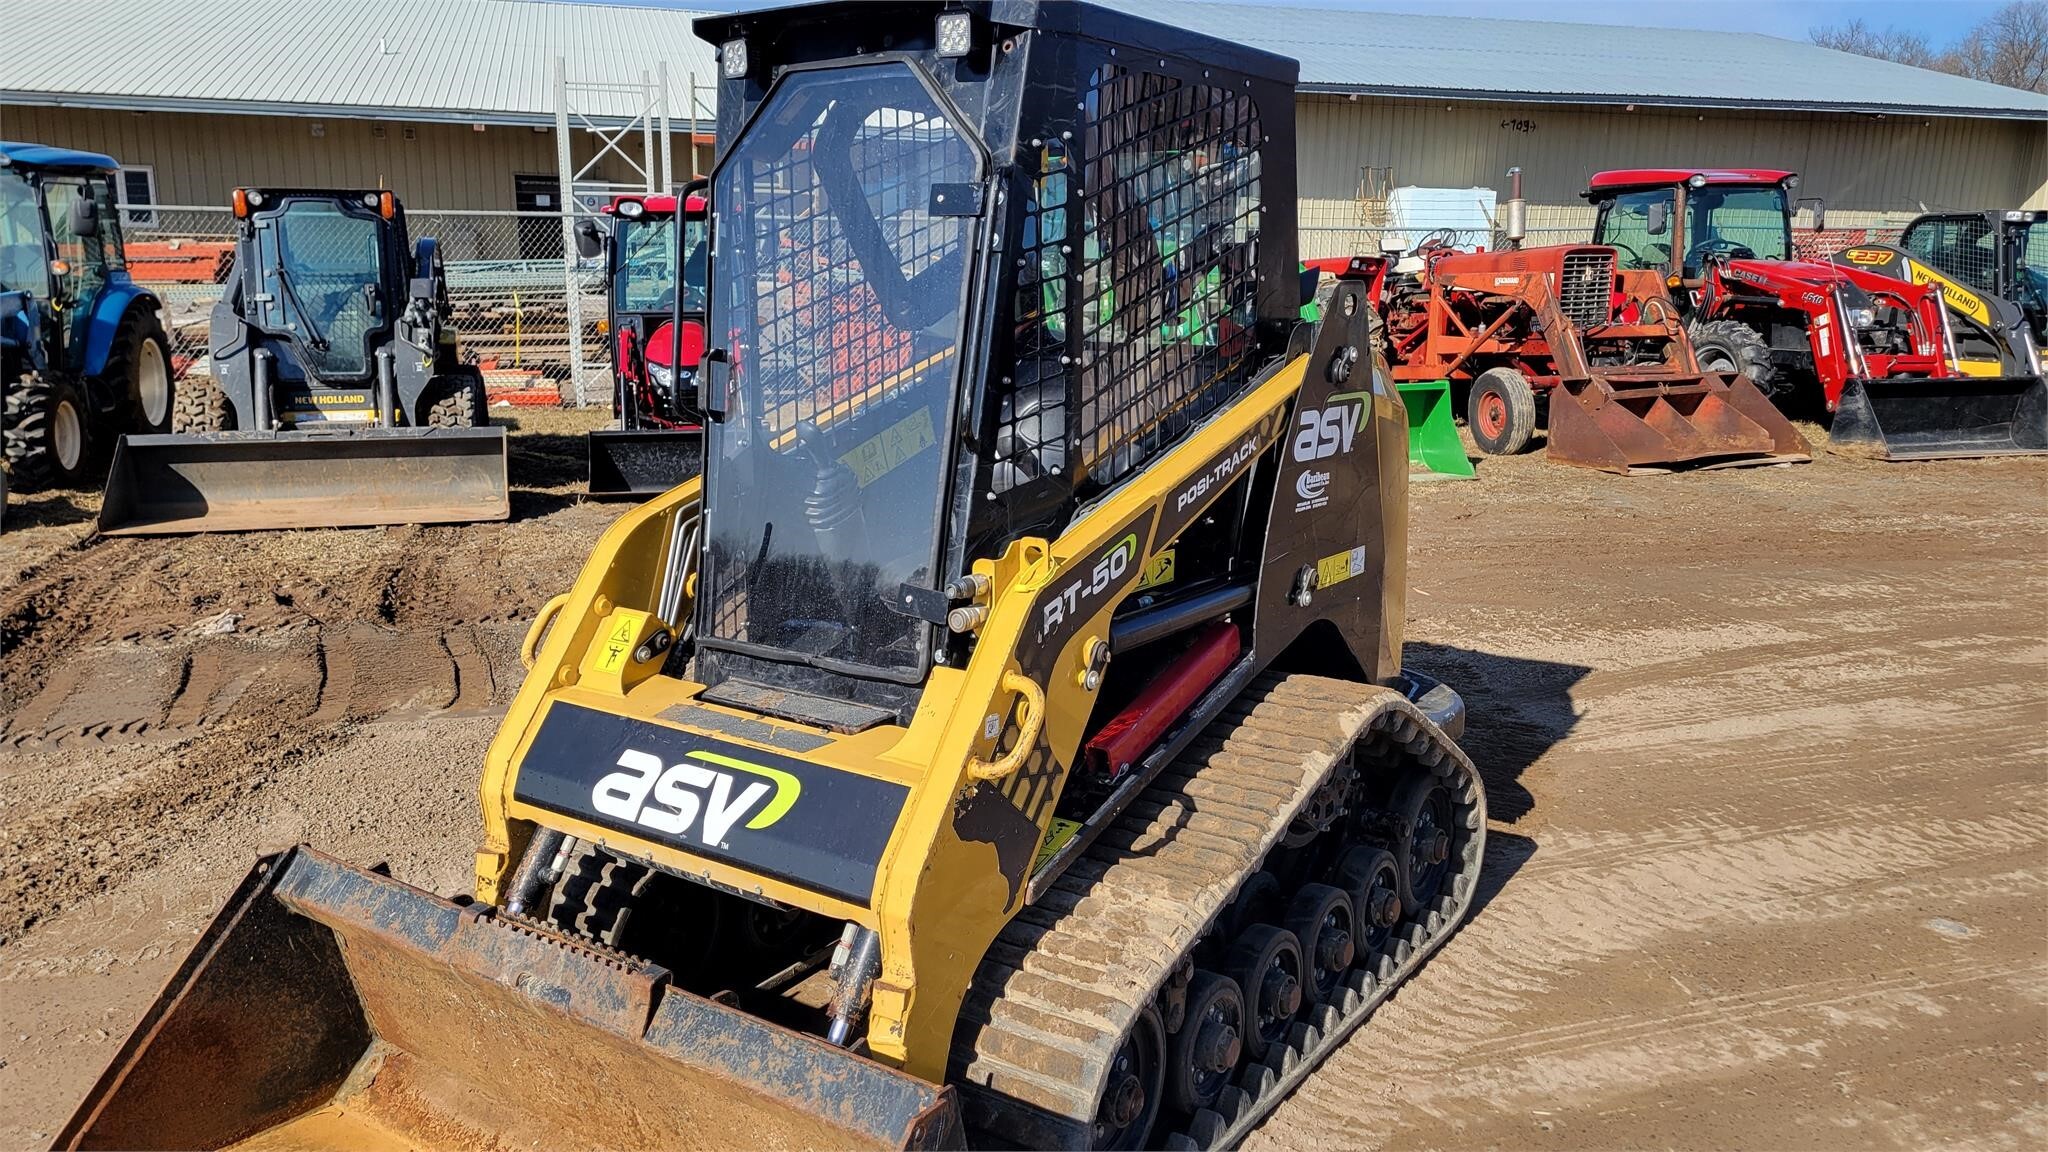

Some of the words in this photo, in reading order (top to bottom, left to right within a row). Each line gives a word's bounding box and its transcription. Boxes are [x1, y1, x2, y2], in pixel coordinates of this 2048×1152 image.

[1846, 250, 1893, 264] C237
[1734, 269, 1760, 282] CASE
[1943, 285, 1977, 310] OLLAND
[295, 395, 318, 404] NEW
[319, 394, 365, 404] HOLLAND
[1177, 436, 1258, 513] POSI-TRACK
[1043, 545, 1127, 636] RT-50
